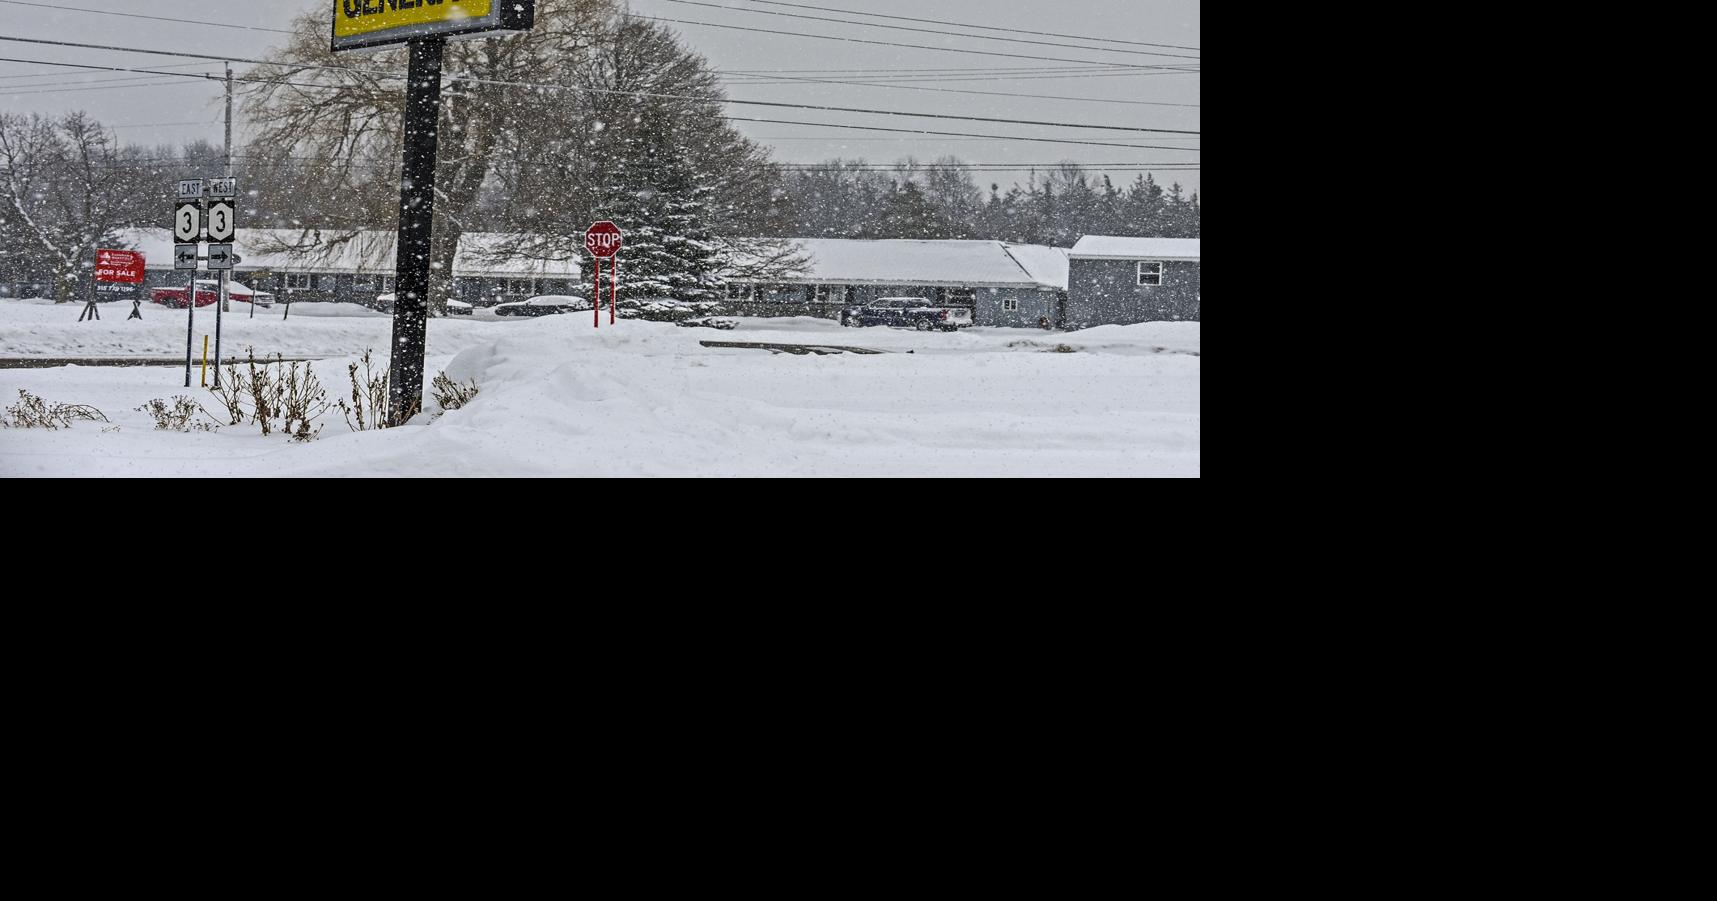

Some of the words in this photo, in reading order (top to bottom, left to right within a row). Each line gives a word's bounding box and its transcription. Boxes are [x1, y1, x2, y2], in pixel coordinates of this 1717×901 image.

[182, 183, 200, 195] EAST
[213, 181, 232, 193] WEST
[182, 211, 192, 234] 3
[215, 210, 226, 232] 3
[587, 232, 620, 248] STOP
[97, 268, 115, 276] FOR
